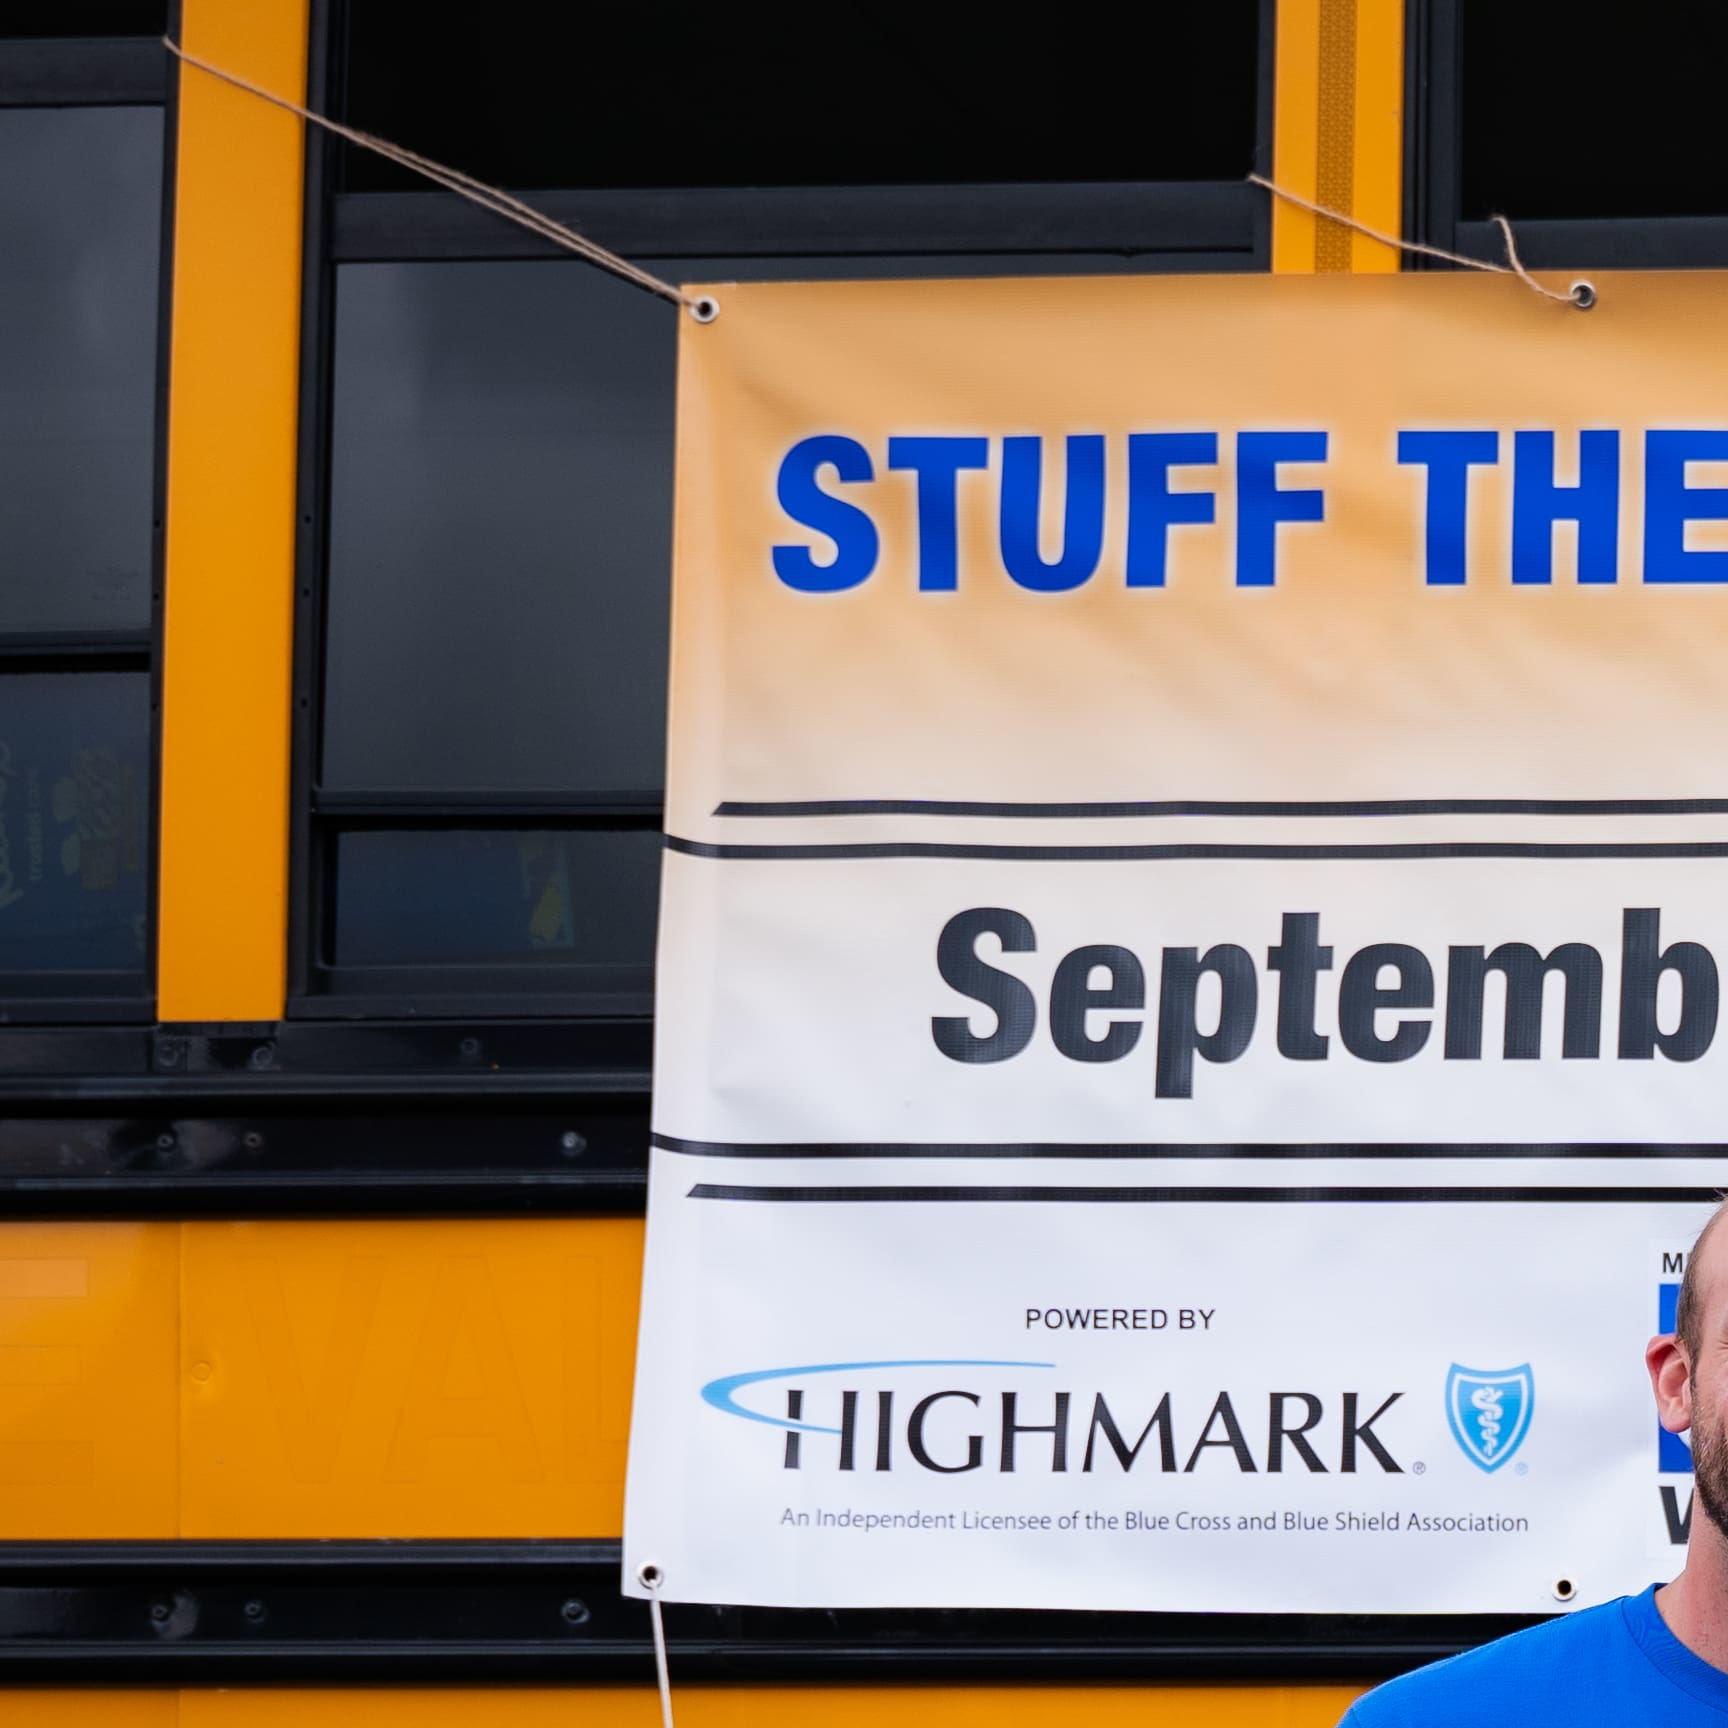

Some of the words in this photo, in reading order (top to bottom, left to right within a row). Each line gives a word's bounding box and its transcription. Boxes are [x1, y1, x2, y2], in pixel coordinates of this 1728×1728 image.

[772, 430, 1328, 593] STUFF
[1025, 1308, 1169, 1331] POWERED
[1178, 1308, 1215, 1331] BY
[784, 1389, 1406, 1474] HIGHMARK
[780, 1507, 810, 1528] An
[815, 1508, 956, 1533] Independent
[962, 1510, 1052, 1531] Licensee
[1057, 1510, 1081, 1531] of
[1085, 1510, 1119, 1531] the
[1125, 1511, 1170, 1531] Blue
[1175, 1511, 1231, 1531] Cross
[1237, 1511, 1277, 1531] and
[1283, 1511, 1329, 1531] Blue
[1335, 1511, 1400, 1532] Shield
[1406, 1512, 1529, 1533] Association
